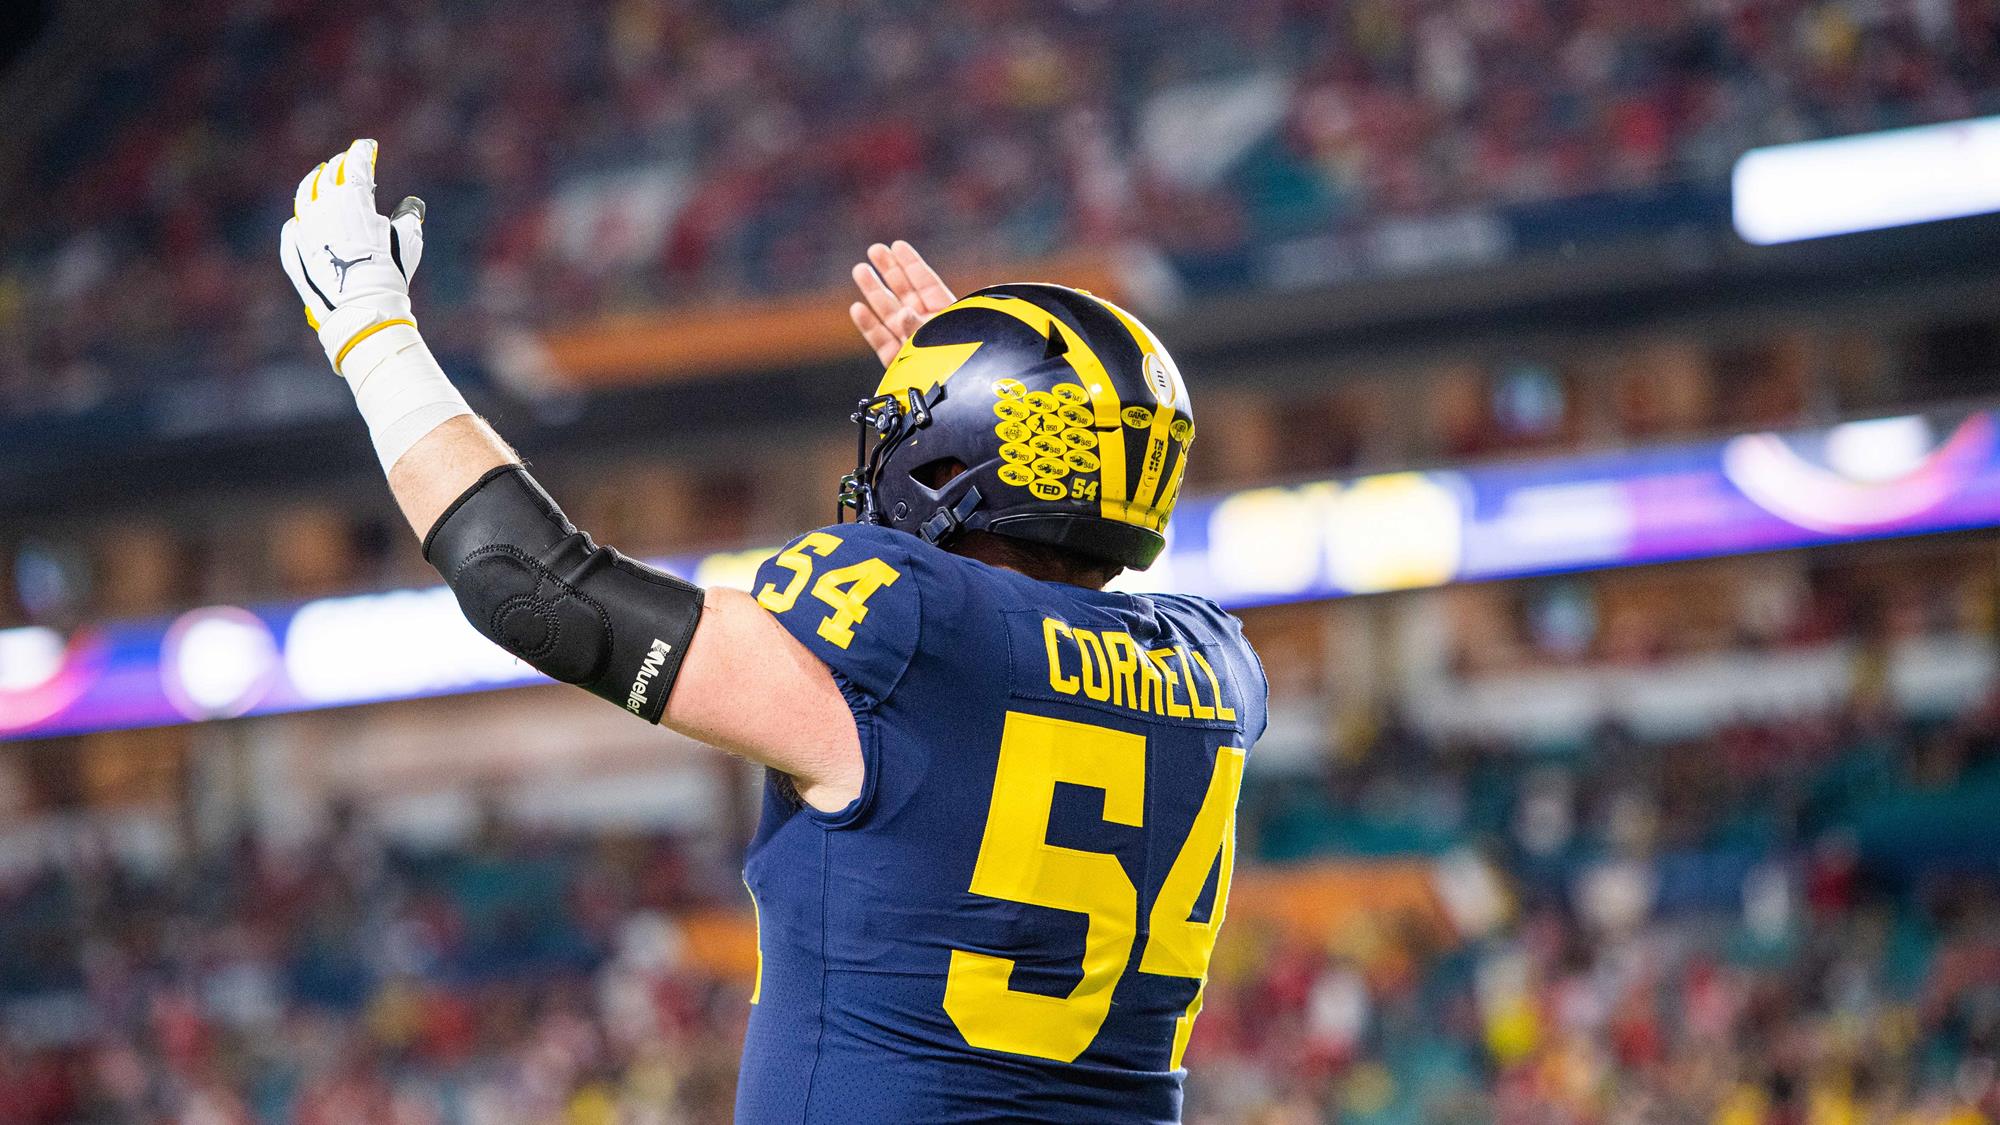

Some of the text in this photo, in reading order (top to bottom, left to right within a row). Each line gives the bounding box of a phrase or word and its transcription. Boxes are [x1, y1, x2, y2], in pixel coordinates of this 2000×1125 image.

[1127, 410, 1149, 421] GAME
[1151, 450, 1162, 462] 42
[1035, 482, 1061, 496] TED
[1071, 477, 1099, 501] 54
[757, 532, 901, 650] 54
[626, 649, 666, 715] Mueller
[943, 710, 1247, 1072] 54
